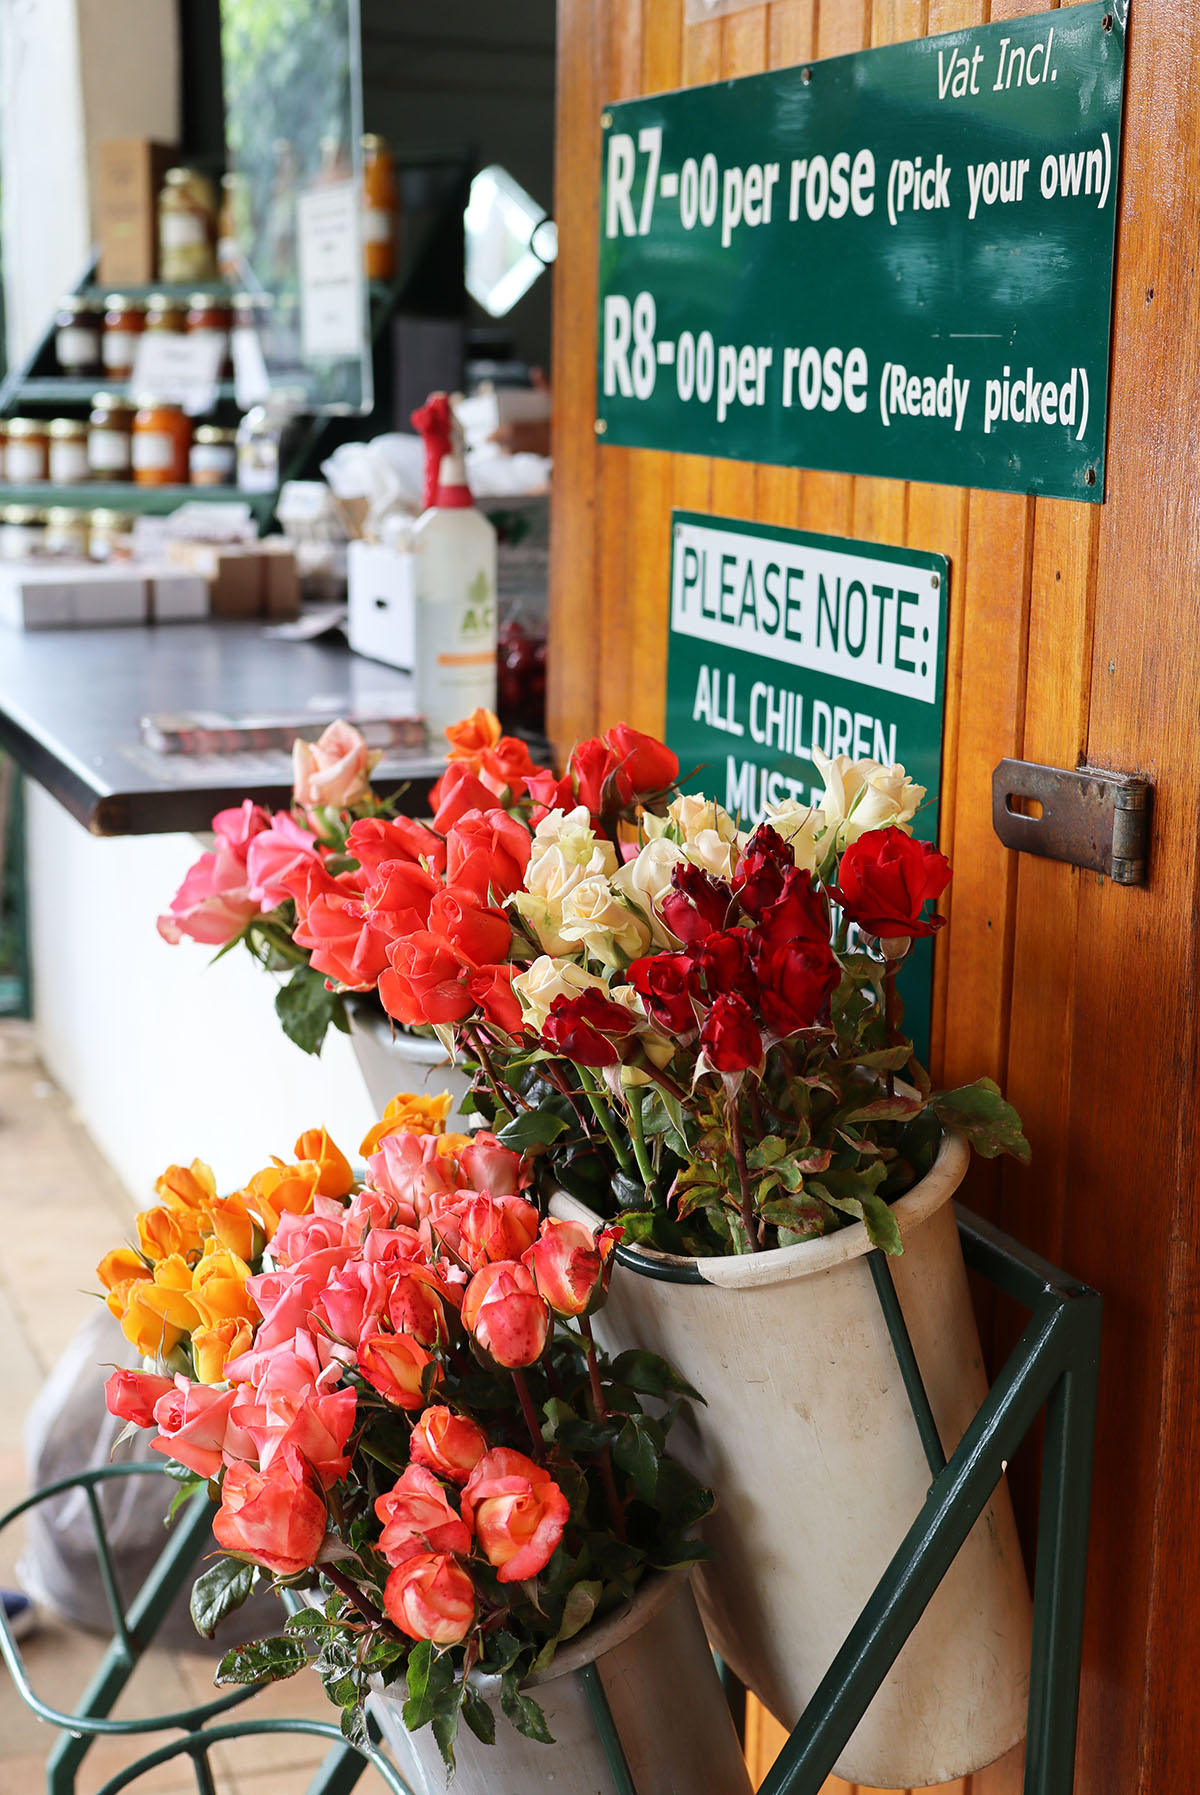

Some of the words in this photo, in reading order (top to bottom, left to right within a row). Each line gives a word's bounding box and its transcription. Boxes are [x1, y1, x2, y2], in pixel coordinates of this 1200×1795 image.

[937, 46, 984, 100] Vat
[992, 26, 1058, 92] Incl.
[721, 160, 780, 248] per
[789, 149, 875, 222] rose
[887, 154, 952, 226] (Pick
[967, 158, 1030, 220] your
[1040, 132, 1112, 209] own)
[717, 341, 773, 423] per
[782, 346, 868, 413] rose
[880, 362, 970, 432] (Ready
[984, 366, 1089, 441] picked)
[682, 546, 804, 643] PLEASE
[816, 573, 930, 678] NOTE:
[693, 664, 744, 737] ALL
[749, 681, 898, 769] CHILDREN
